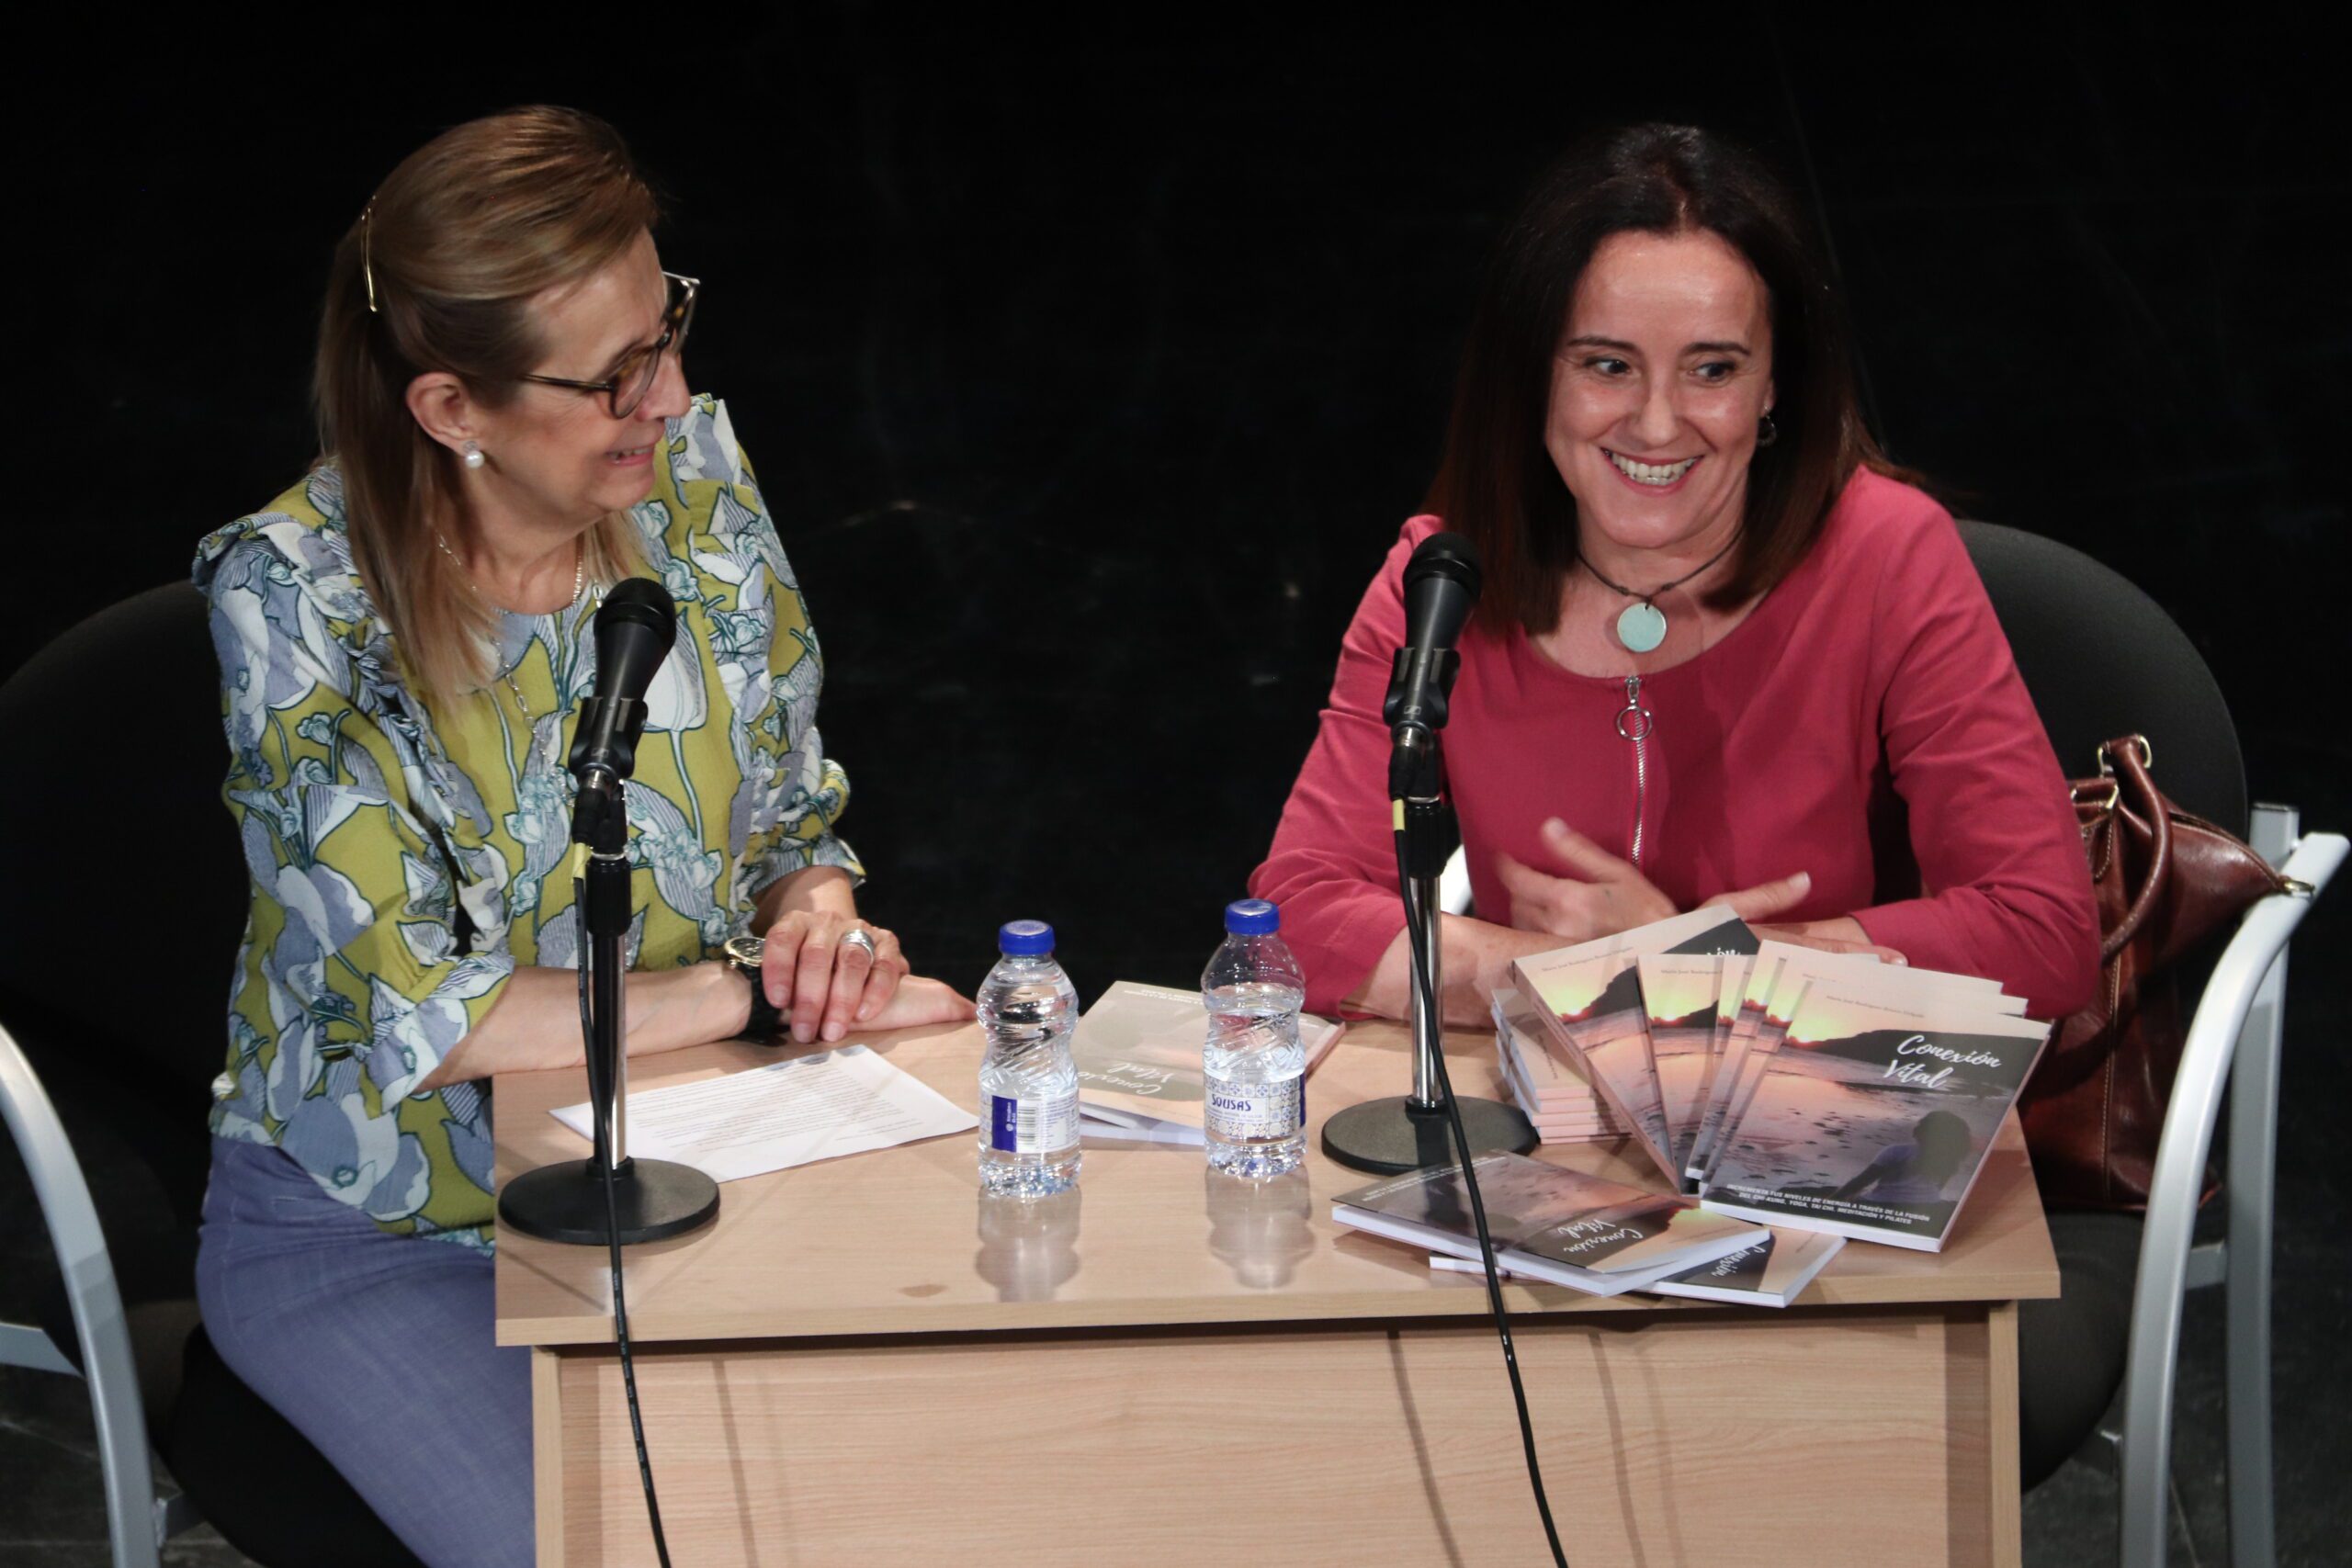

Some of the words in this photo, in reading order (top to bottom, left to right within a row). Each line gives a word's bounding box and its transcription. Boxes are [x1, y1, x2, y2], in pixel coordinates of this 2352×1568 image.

[1896, 1034, 2002, 1068] Conexión
[1883, 1059, 1954, 1089] Vital
[1557, 1219, 1617, 1239] Vital
[1563, 1228, 1644, 1253] Conexión
